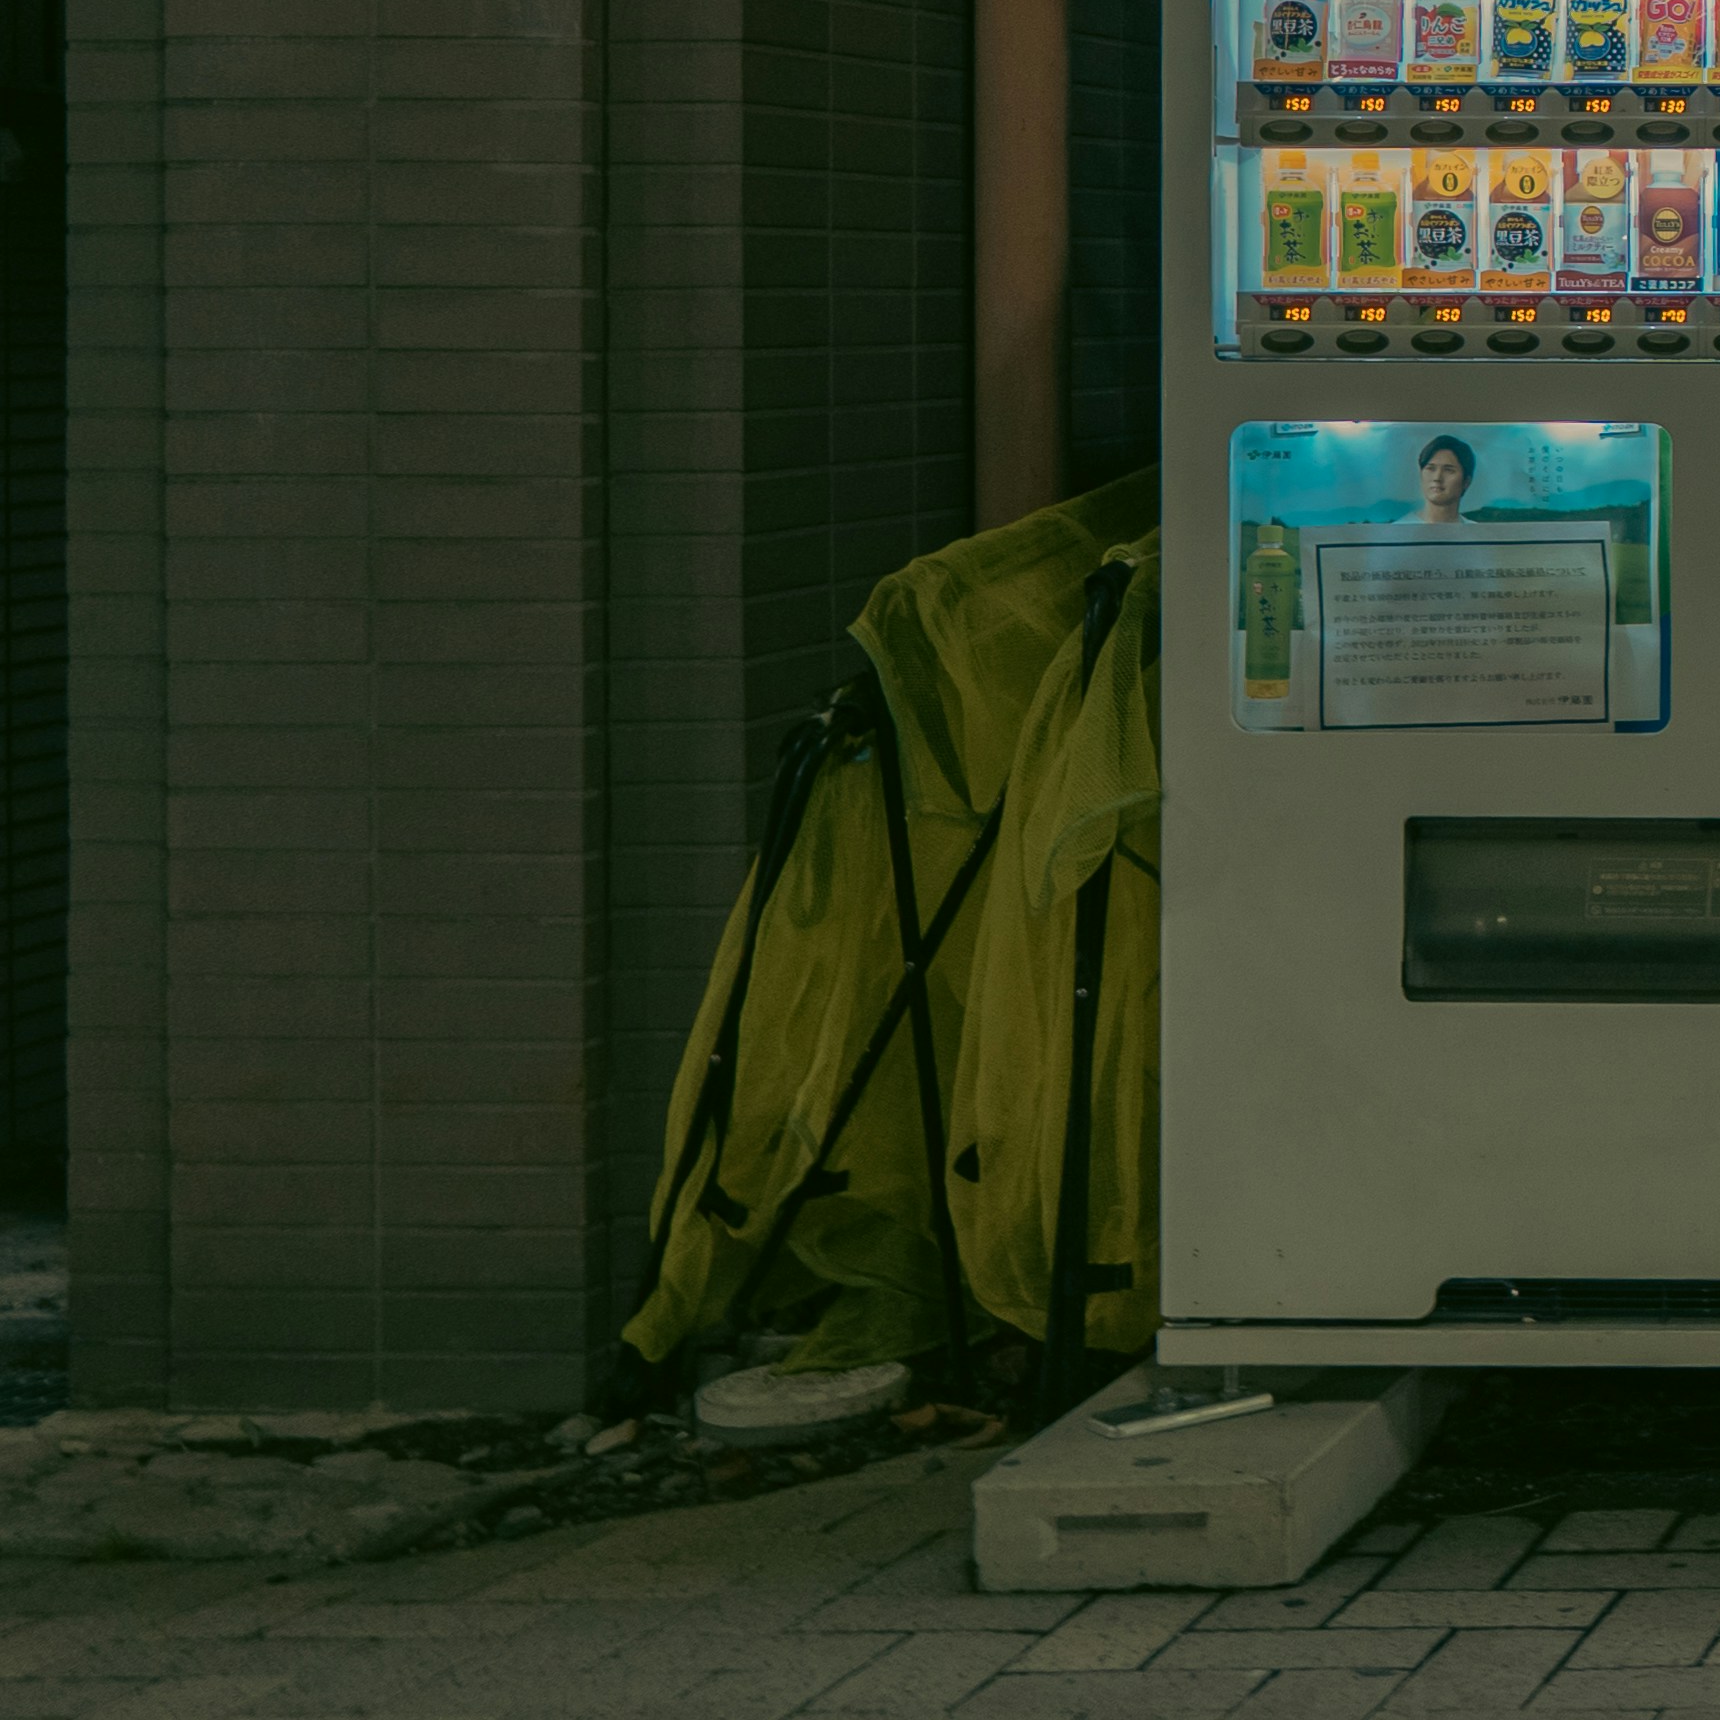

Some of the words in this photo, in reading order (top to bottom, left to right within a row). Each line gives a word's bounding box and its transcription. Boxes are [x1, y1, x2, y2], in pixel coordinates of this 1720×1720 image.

[1270, 19, 1314, 36] 黒豆茶
[1420, 16, 1467, 34] りんご
[1428, 35, 1455, 47] 三兄弟
[1258, 66, 1318, 78] やさしい甘み
[1330, 63, 1396, 77] とろっとなめらか
[1285, 97, 1311, 111] 150
[1361, 97, 1385, 111] 150
[1660, 100, 1686, 113] 130
[1434, 163, 1470, 171] カフェイン
[1594, 165, 1613, 174] 紅茶
[1586, 176, 1620, 187] 際立つ
[1418, 227, 1463, 244] 黒豆茶
[1496, 229, 1540, 246] 黒豆茶
[1650, 245, 1684, 255] Creamy
[1642, 255, 1696, 267] COCOA
[1408, 275, 1470, 286] やさしい甘み
